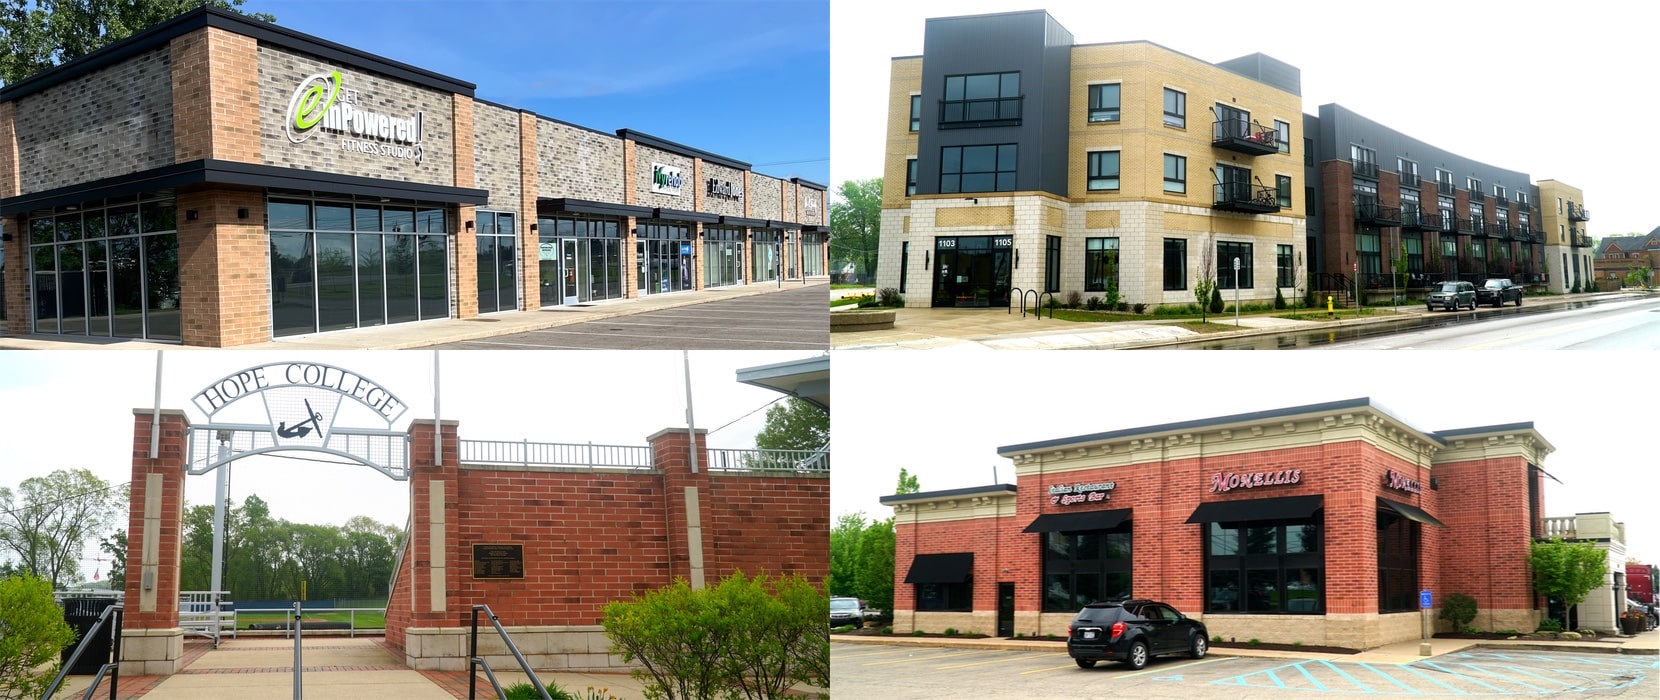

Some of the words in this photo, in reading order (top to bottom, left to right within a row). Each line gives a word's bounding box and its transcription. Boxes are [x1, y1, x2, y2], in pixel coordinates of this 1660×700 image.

[338, 87, 359, 104] GET
[341, 138, 379, 155] FITNESS
[380, 144, 413, 159] STUDIO
[938, 239, 956, 247] 1103
[994, 238, 1012, 246] 1105
[201, 367, 269, 410] HOPE
[285, 363, 400, 417] COLLEGE
